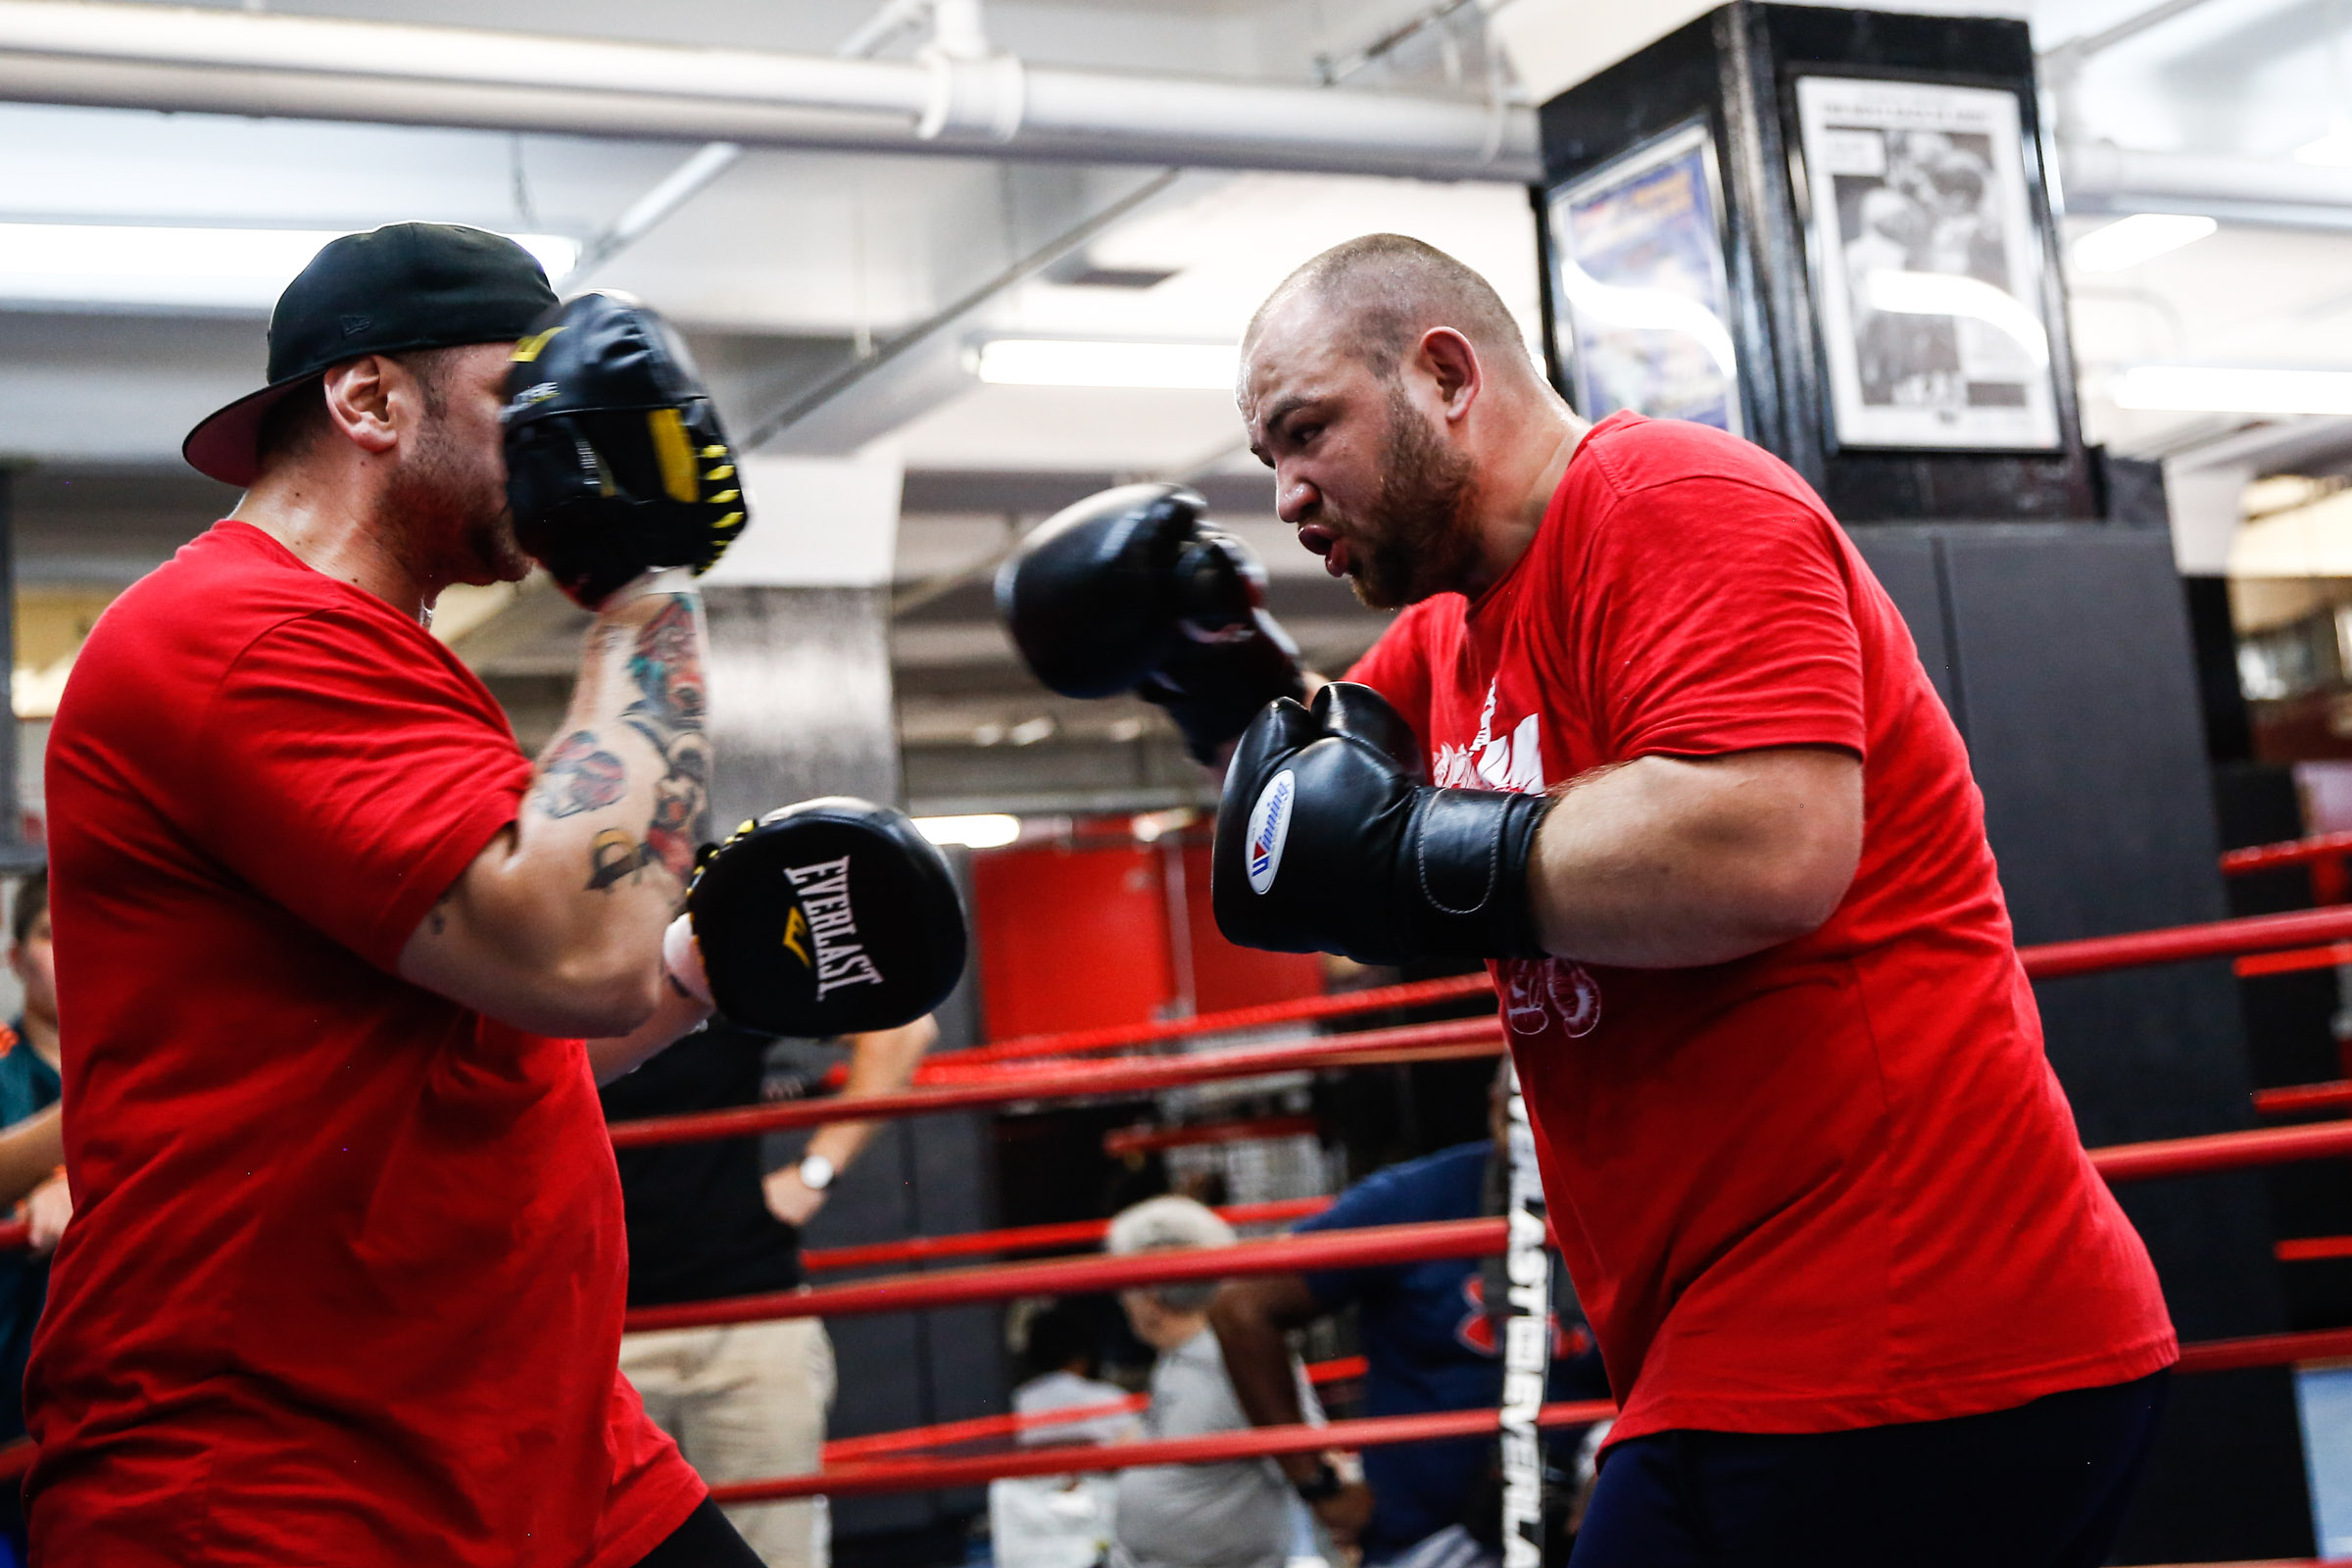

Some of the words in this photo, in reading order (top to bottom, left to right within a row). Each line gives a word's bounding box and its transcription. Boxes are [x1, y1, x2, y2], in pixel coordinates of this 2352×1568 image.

[1251, 781, 1290, 877] Winning
[784, 855, 884, 1002] EVERLAST
[1506, 1060, 1547, 1315] ERLAST
